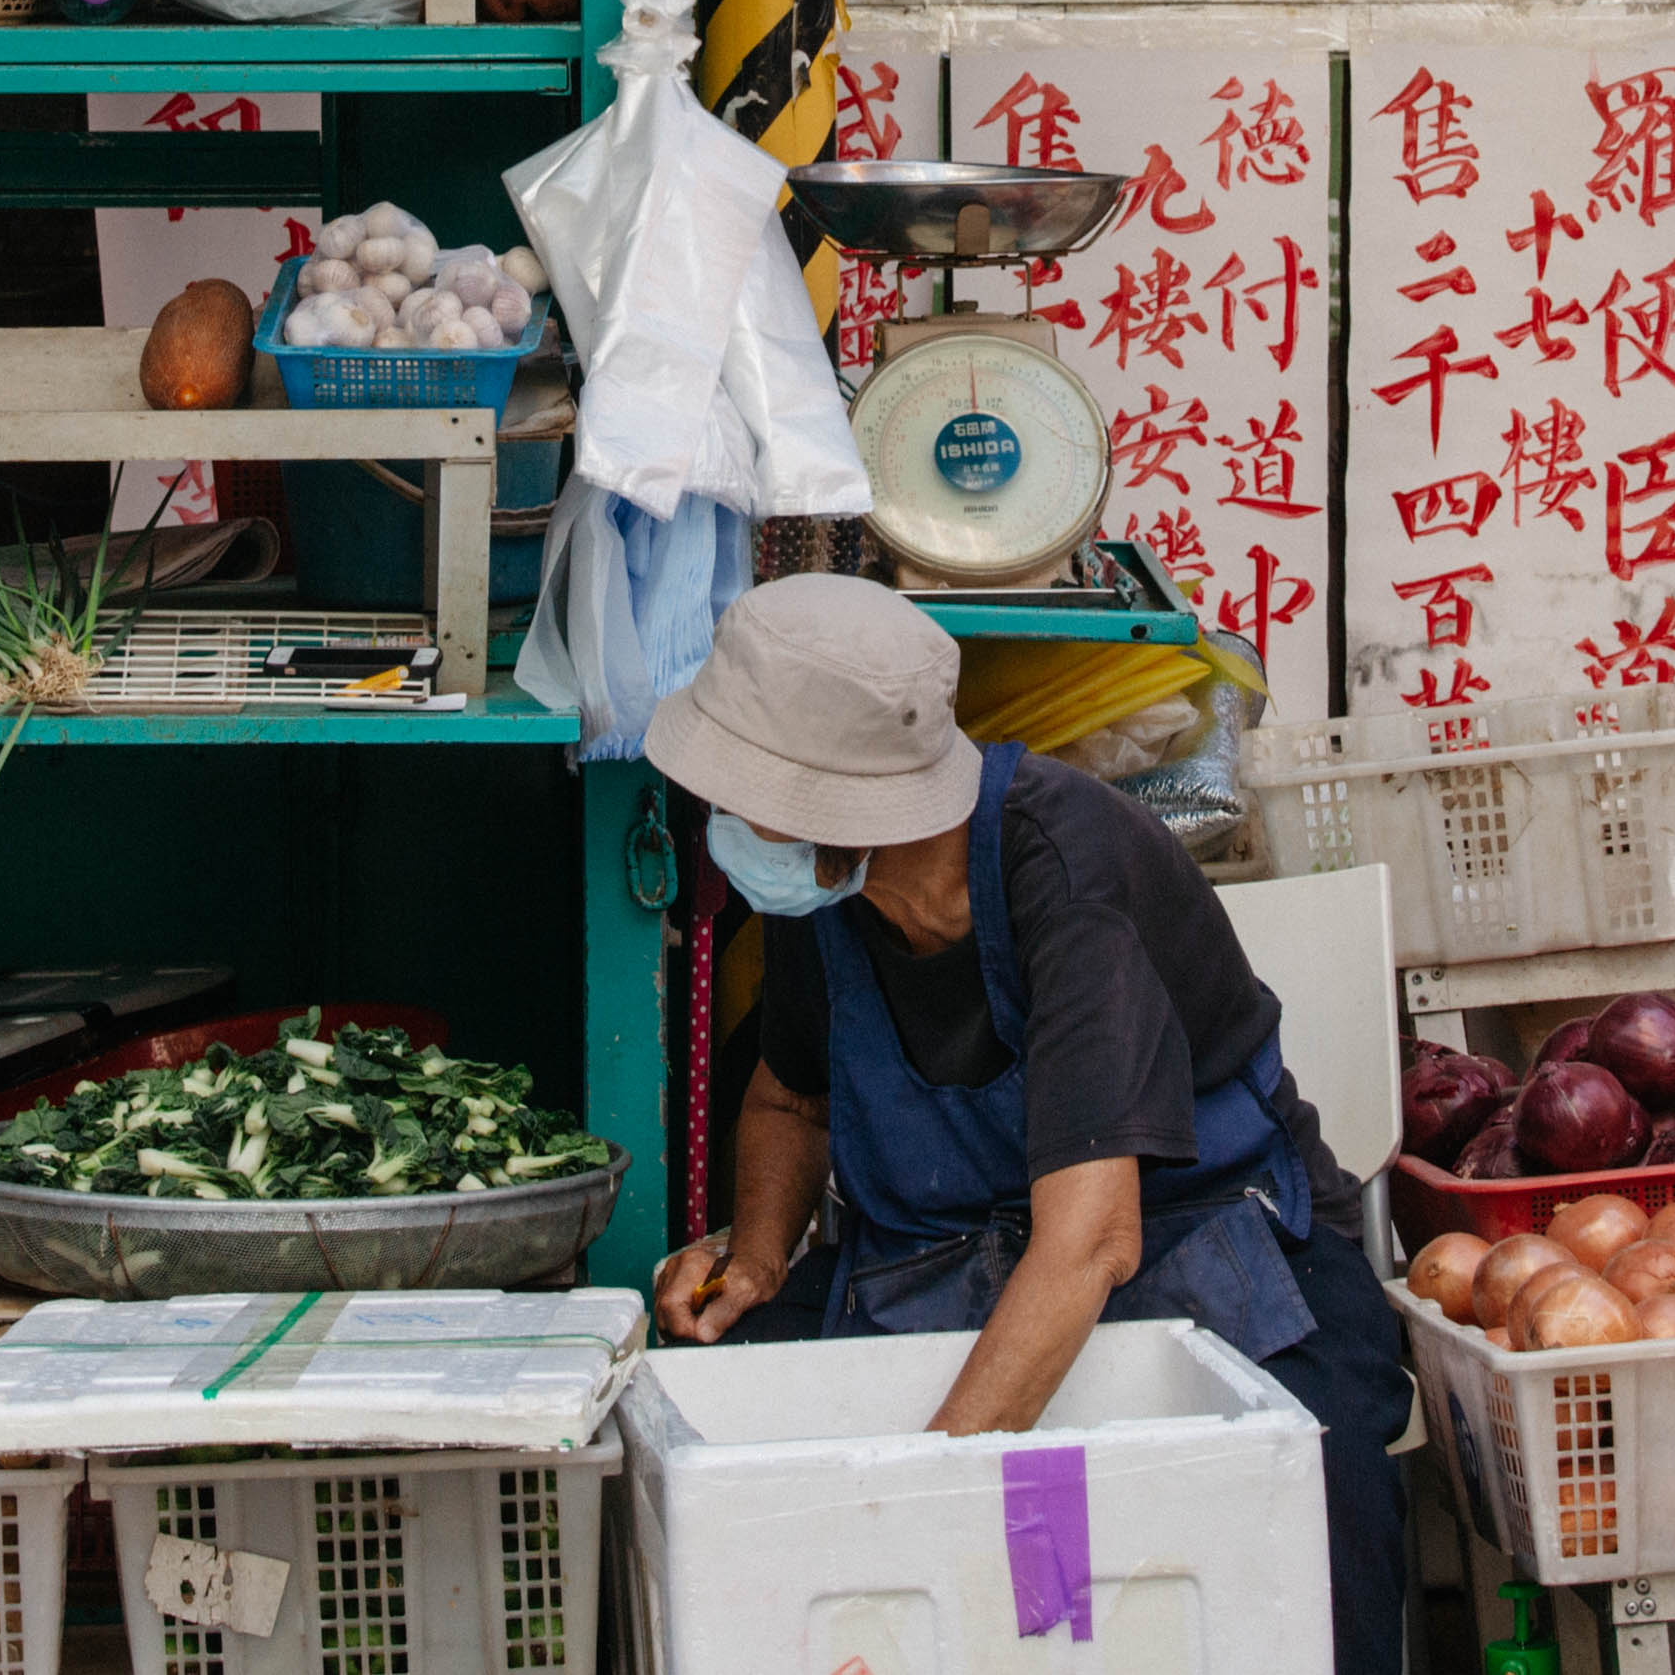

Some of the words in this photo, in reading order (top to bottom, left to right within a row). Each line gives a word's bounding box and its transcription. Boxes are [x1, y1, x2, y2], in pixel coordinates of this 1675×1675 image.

[940, 438, 1015, 460] ISHIDA
[1493, 189, 1597, 532] 十七樓
